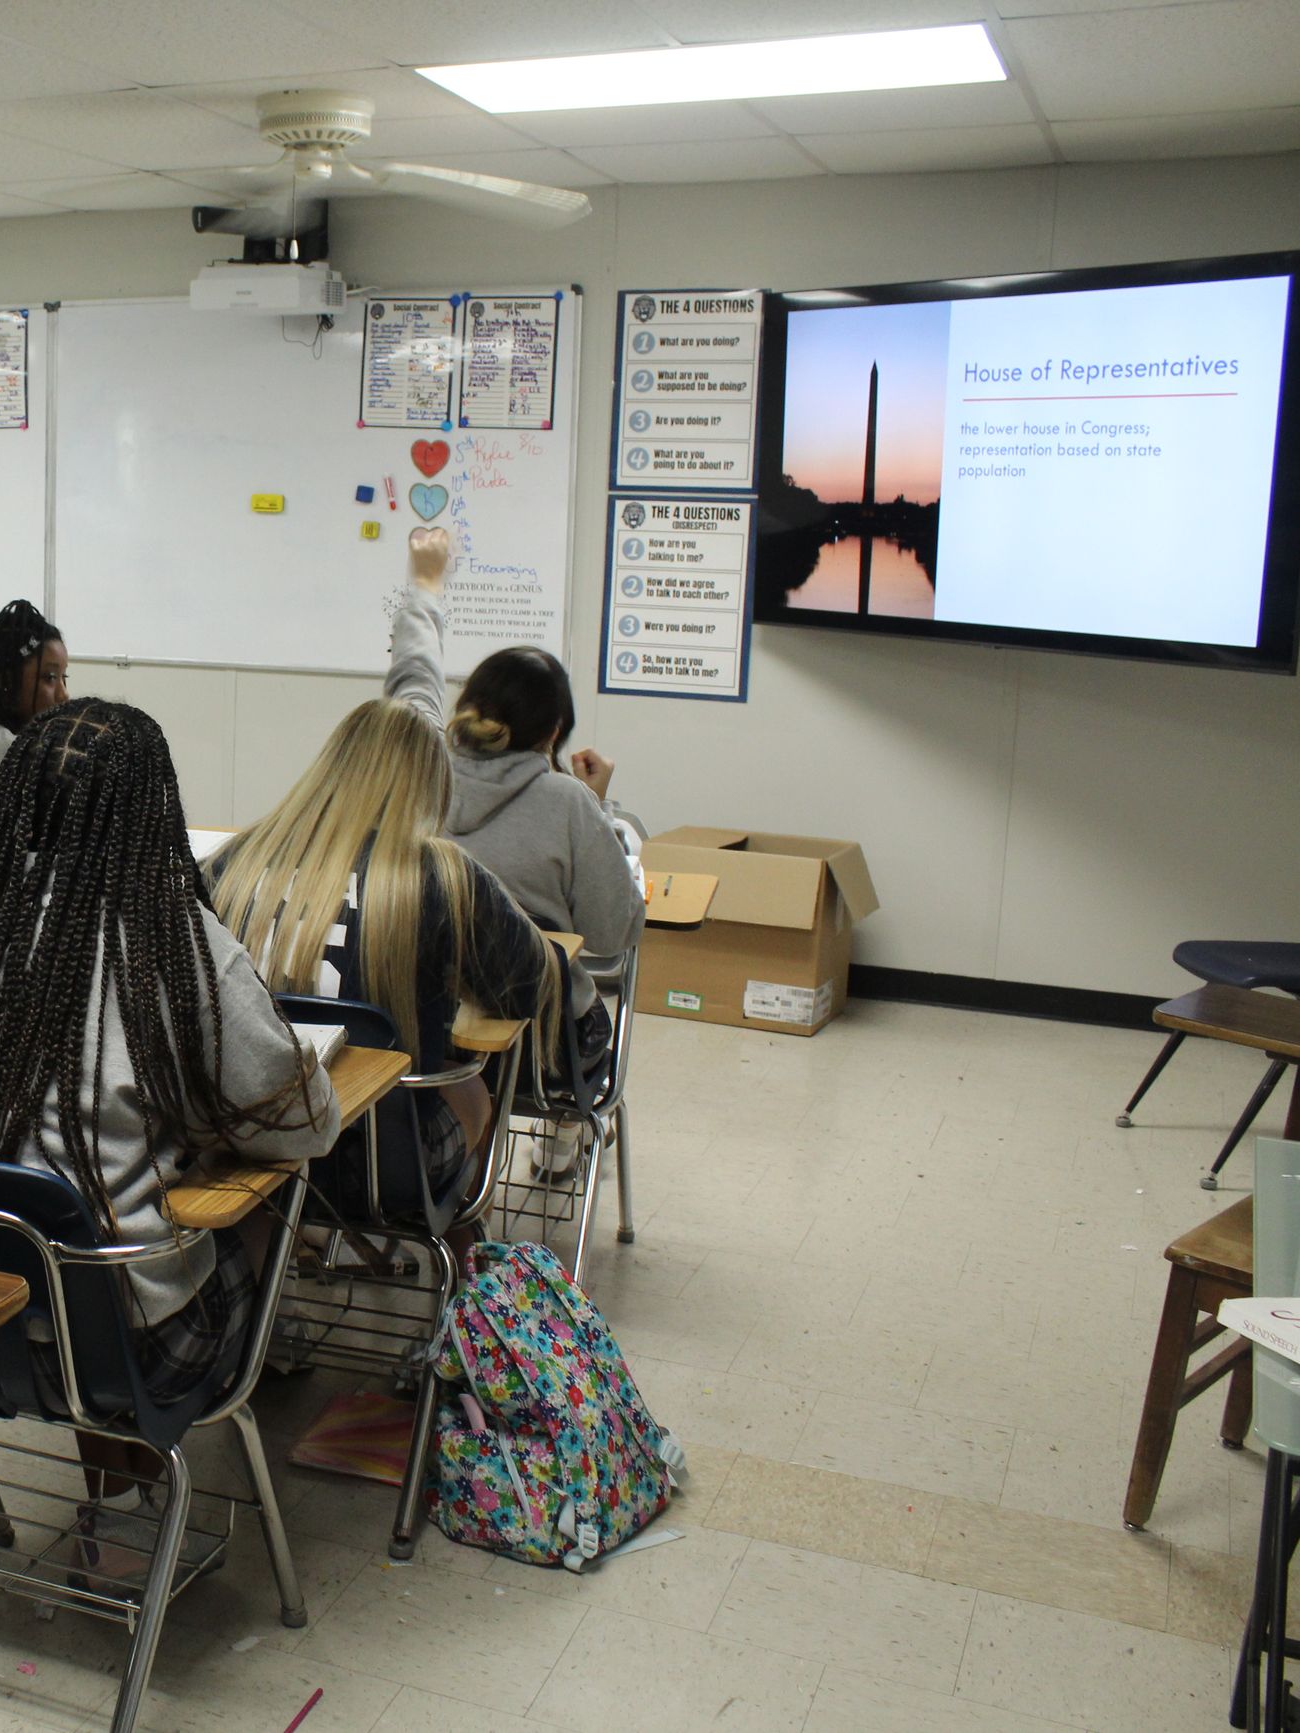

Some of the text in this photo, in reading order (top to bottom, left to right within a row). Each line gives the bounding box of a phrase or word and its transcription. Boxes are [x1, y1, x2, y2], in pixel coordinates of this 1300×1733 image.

[660, 299, 754, 314] THE 4 QUESTIONS
[636, 331, 650, 353] 1
[660, 336, 740, 348] What are you doing?
[658, 370, 708, 382] What are you
[964, 355, 1239, 385] House of Representatives
[635, 372, 650, 389] 2
[657, 381, 747, 392] supposed to be doing?
[634, 412, 646, 430] 3
[656, 416, 722, 426] Are you doing it?
[960, 420, 1150, 437] the lower house in Congress;
[654, 450, 705, 460] What are you
[960, 442, 1162, 458] representation based on state
[630, 449, 645, 469] 4
[654, 460, 734, 470] going to do about it?
[958, 464, 1026, 480] population
[652, 506, 740, 521] THE 4 QUESTIONS
[672, 520, 718, 531] (DISRESPECT)
[628, 540, 638, 558] 1
[648, 538, 696, 550] How are you
[648, 552, 704, 562] talking to me?
[444, 582, 496, 592] EVERYBODY
[510, 584, 542, 592] GENIUS
[624, 578, 638, 595] 2
[646, 577, 715, 590] How did we agree
[646, 588, 730, 601] to talk to each other?
[623, 618, 635, 634] 3
[644, 622, 716, 634] Were you doing it?
[620, 654, 634, 673] 4
[642, 654, 703, 667] So, how are you
[642, 665, 719, 678] going to talk to me?
[1243, 1319, 1270, 1340] SOUND
[1268, 1332, 1298, 1354] SPEECH
